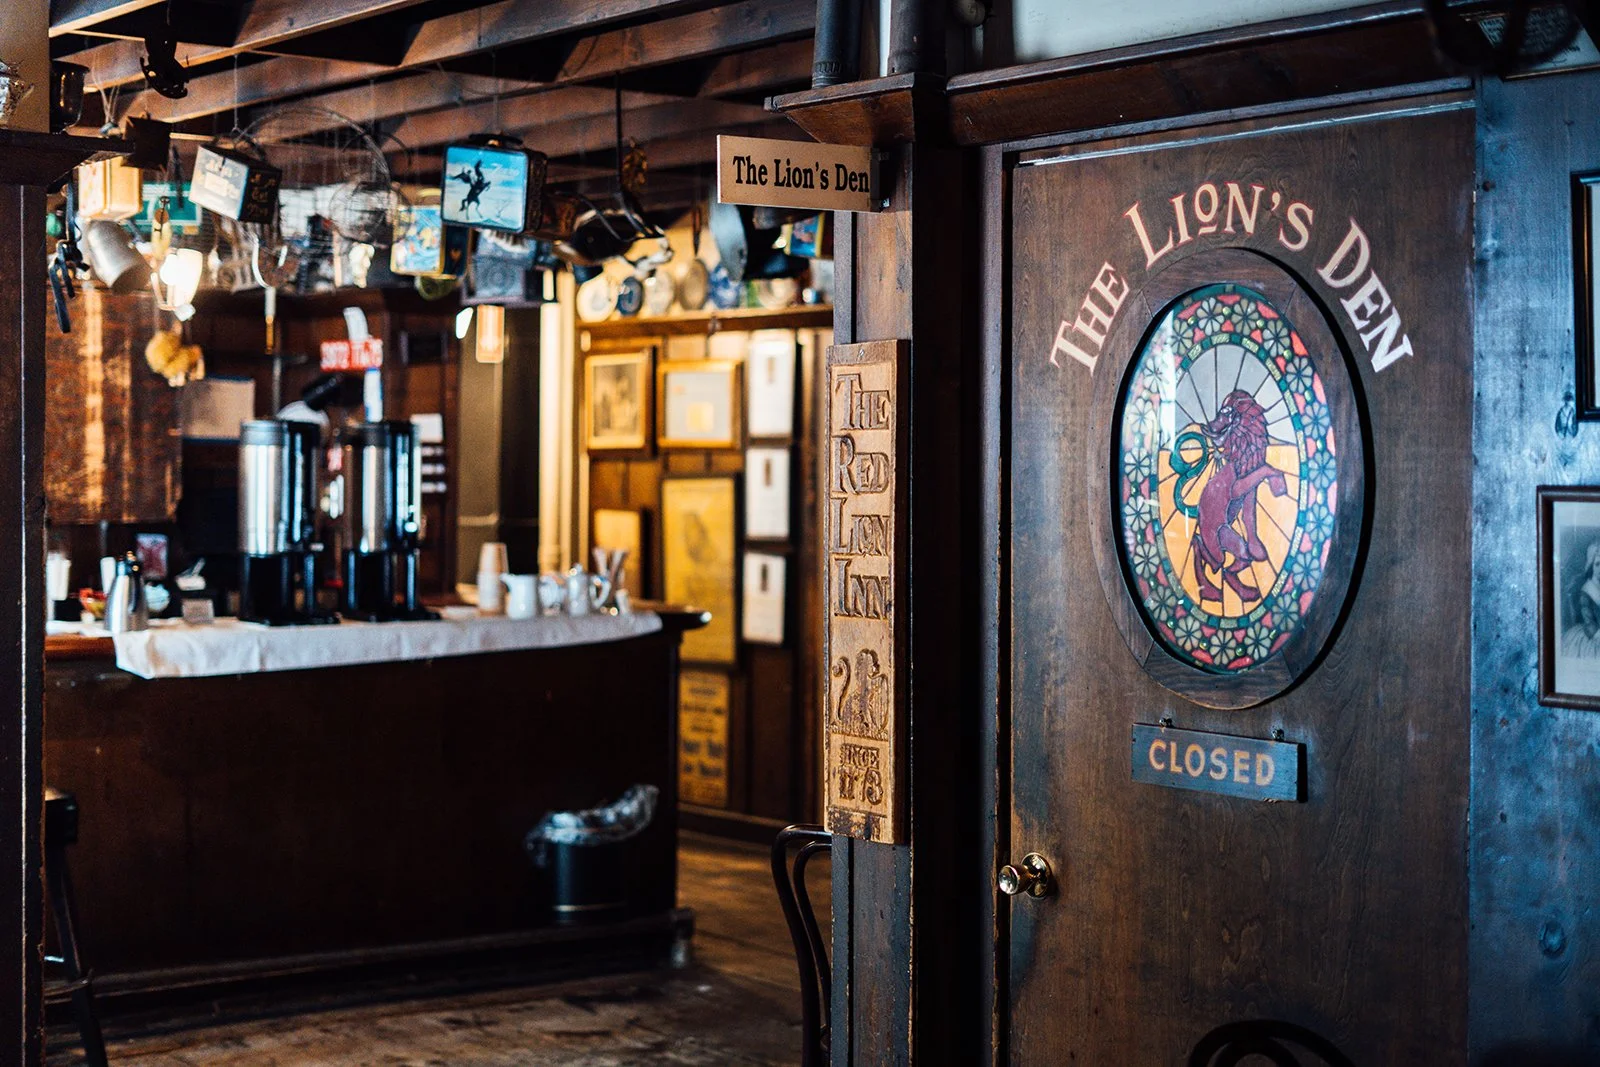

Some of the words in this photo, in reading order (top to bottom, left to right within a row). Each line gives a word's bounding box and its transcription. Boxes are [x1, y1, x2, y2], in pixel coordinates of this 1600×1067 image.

[733, 155, 768, 186] The
[774, 158, 829, 190] Lion's
[835, 163, 870, 193] Den
[1049, 261, 1130, 377] THE
[1123, 181, 1314, 271] LION'S
[1316, 216, 1414, 373] DEN
[835, 373, 890, 430] THE
[831, 433, 890, 494] RED
[830, 497, 890, 557] LION
[833, 559, 889, 620] INN
[839, 742, 880, 770] SINCE
[1148, 738, 1276, 787] CLOSED
